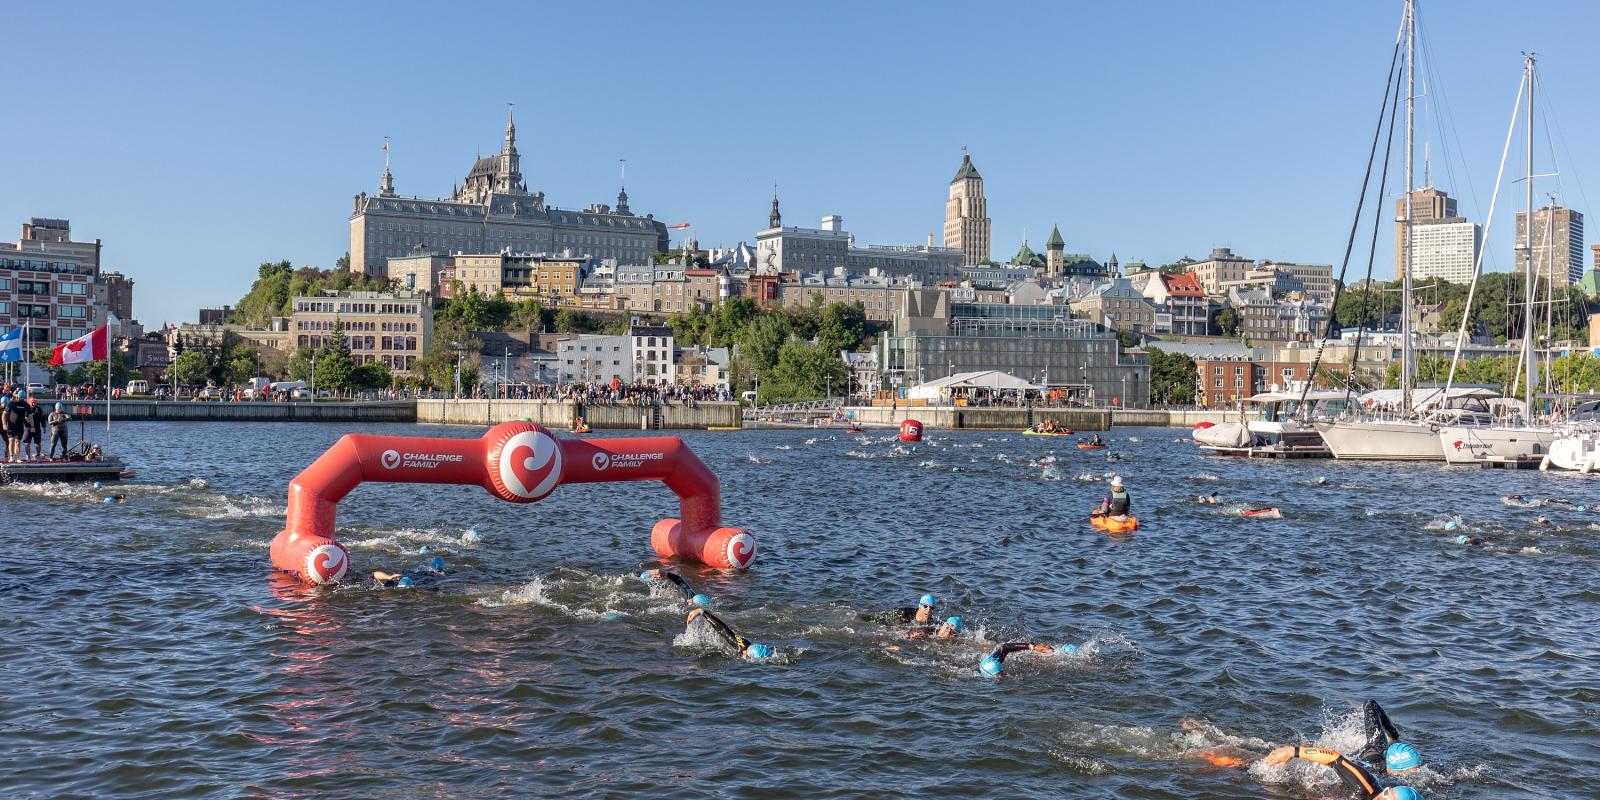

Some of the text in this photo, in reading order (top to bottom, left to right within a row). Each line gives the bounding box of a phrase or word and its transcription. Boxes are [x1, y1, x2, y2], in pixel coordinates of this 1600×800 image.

[147, 354, 168, 362] Swee
[403, 453, 462, 462] CHALLENGE
[611, 453, 664, 461] CHALLENGE
[403, 460, 440, 468] FAMILY
